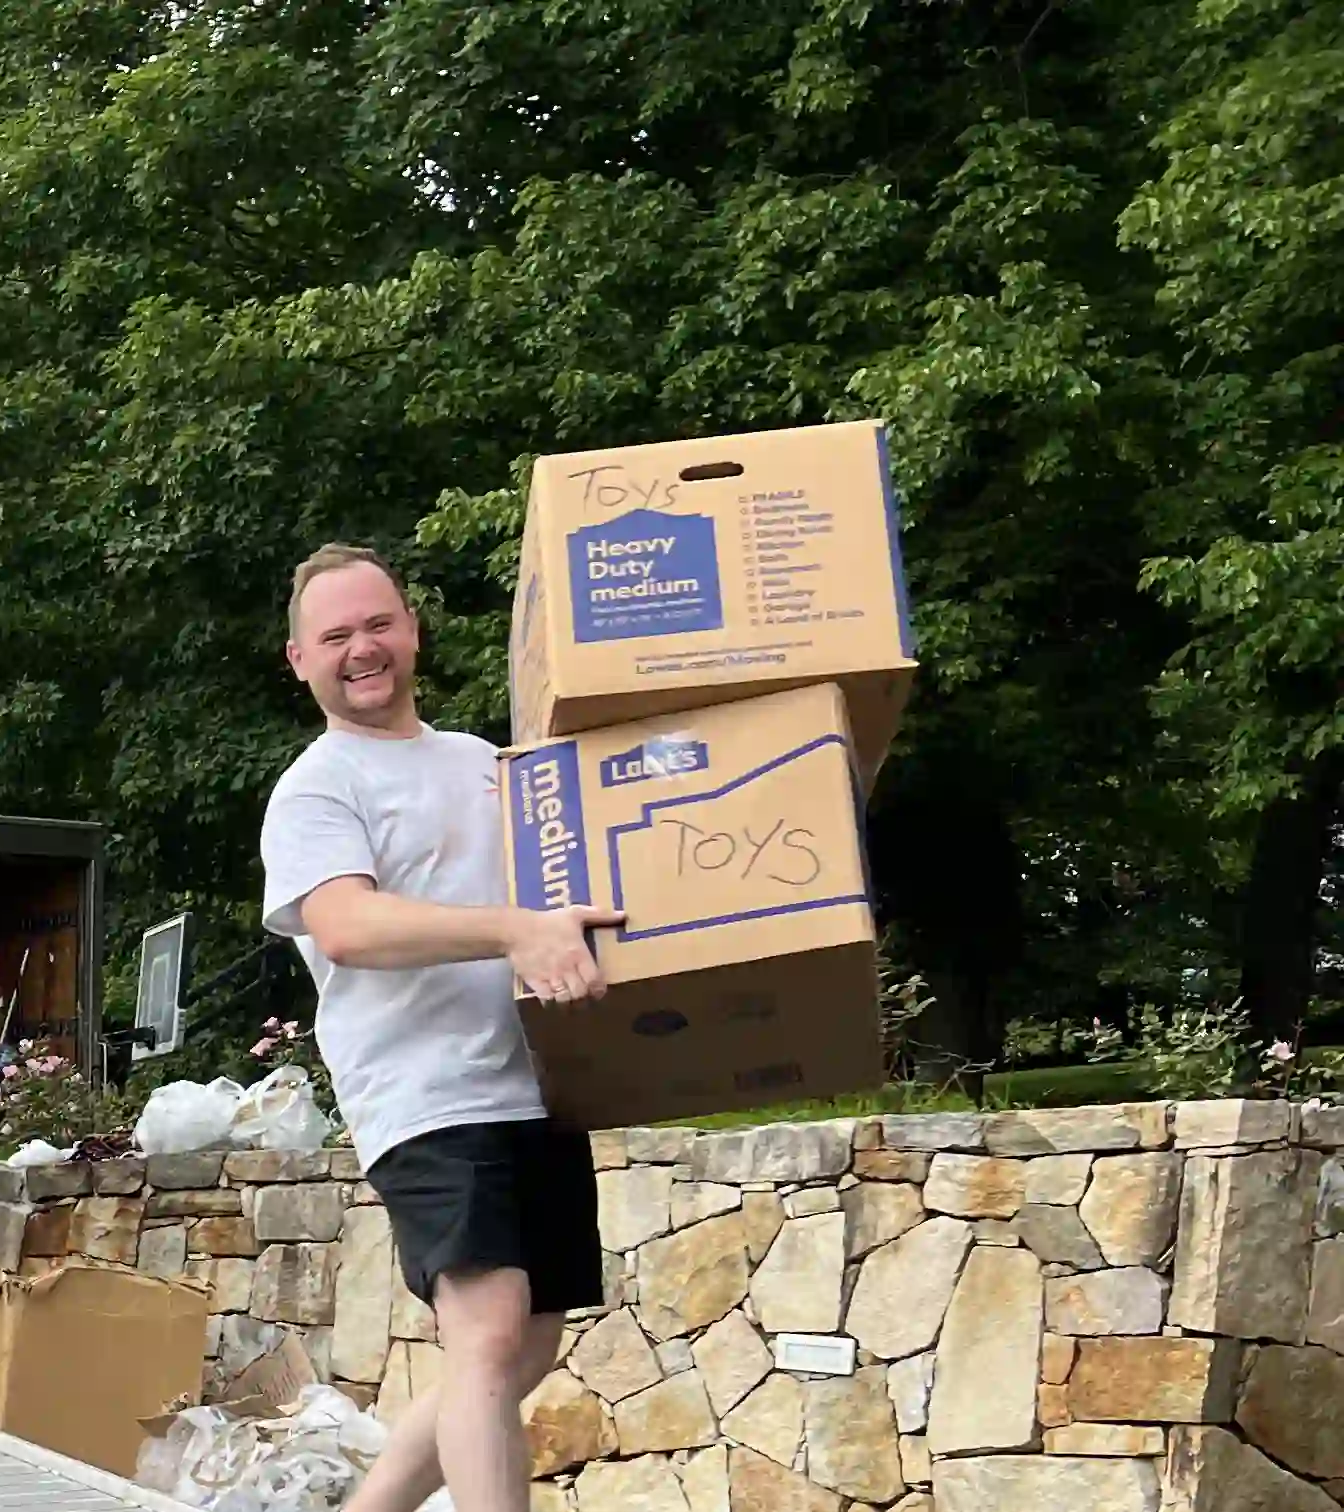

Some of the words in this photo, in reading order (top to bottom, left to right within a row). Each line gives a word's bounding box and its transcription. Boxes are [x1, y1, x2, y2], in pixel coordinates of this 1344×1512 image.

[586, 536, 676, 559] Heavy
[588, 559, 655, 580] Duty
[590, 577, 699, 602] medium
[660, 819, 820, 886] TOYS
